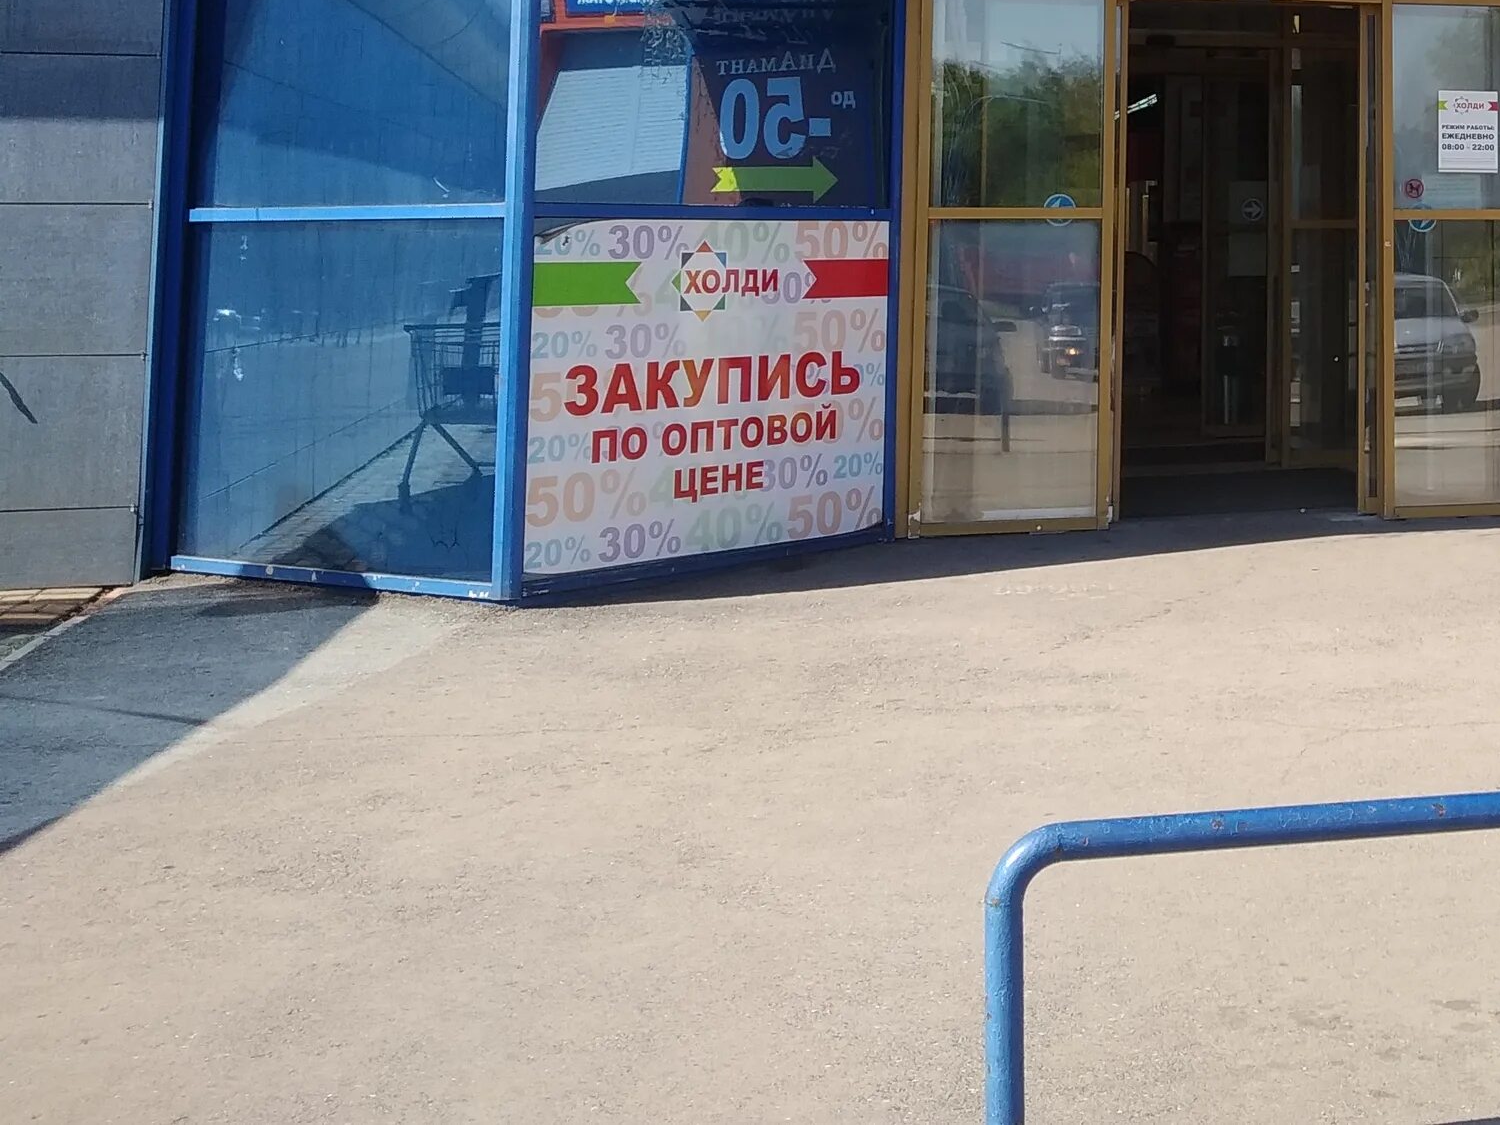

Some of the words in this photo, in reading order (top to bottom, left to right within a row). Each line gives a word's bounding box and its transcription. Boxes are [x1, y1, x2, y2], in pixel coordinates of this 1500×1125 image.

[1456, 102, 1485, 111] ХОЛДИ
[1441, 133, 1495, 141] ЕЖЕДНЕВНО
[1441, 143, 1465, 151] 08:00
[1471, 143, 1495, 151] 22:00
[684, 268, 778, 298] ХОЛДИ
[564, 350, 861, 417] ЗАКУПИСЬ
[591, 426, 648, 464] ПО
[661, 402, 837, 457] ОПТОВОЙ
[673, 460, 764, 503] ЦЕНЕ
[597, 518, 682, 563] 30%
